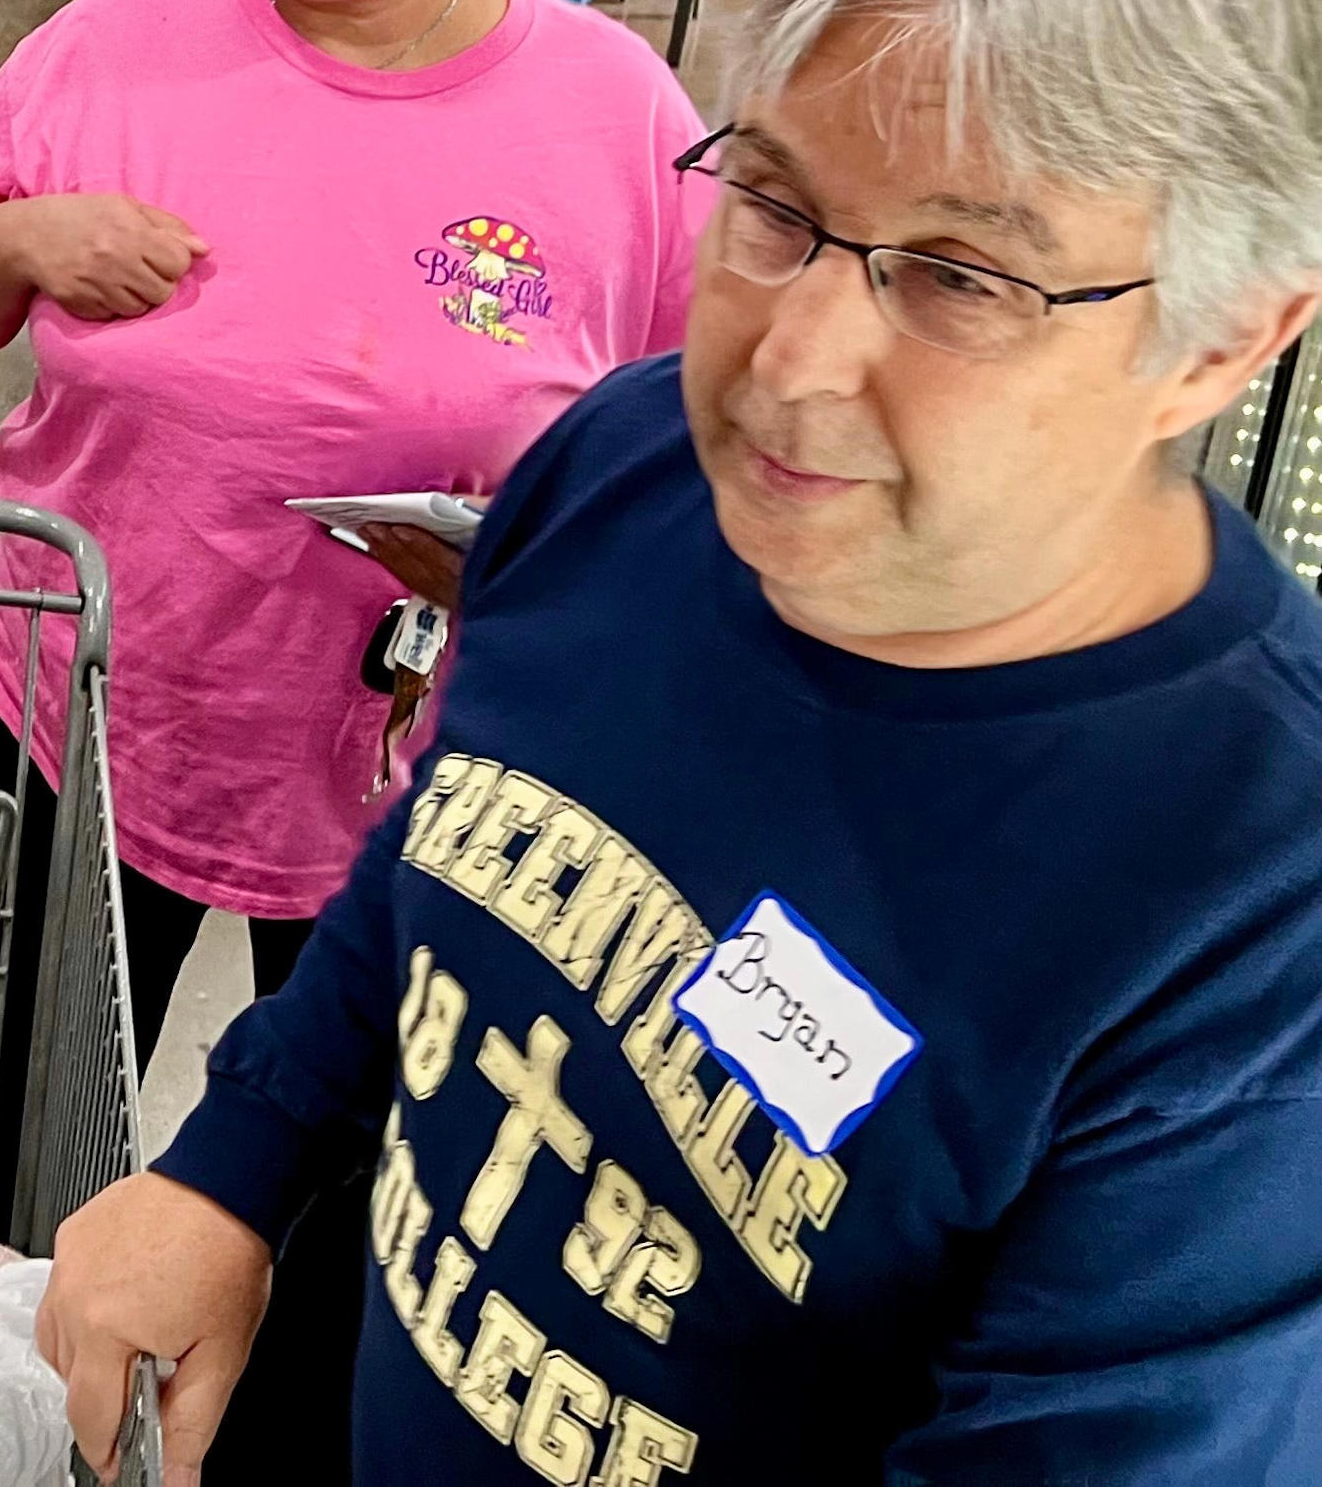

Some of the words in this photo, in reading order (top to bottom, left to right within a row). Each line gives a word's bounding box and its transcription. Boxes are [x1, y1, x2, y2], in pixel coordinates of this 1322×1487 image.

[414, 248, 506, 298] Blessed
[715, 931, 853, 1081] Bryan
[370, 1103, 699, 1487] OLLEGE
[562, 1158, 703, 1345] 92
